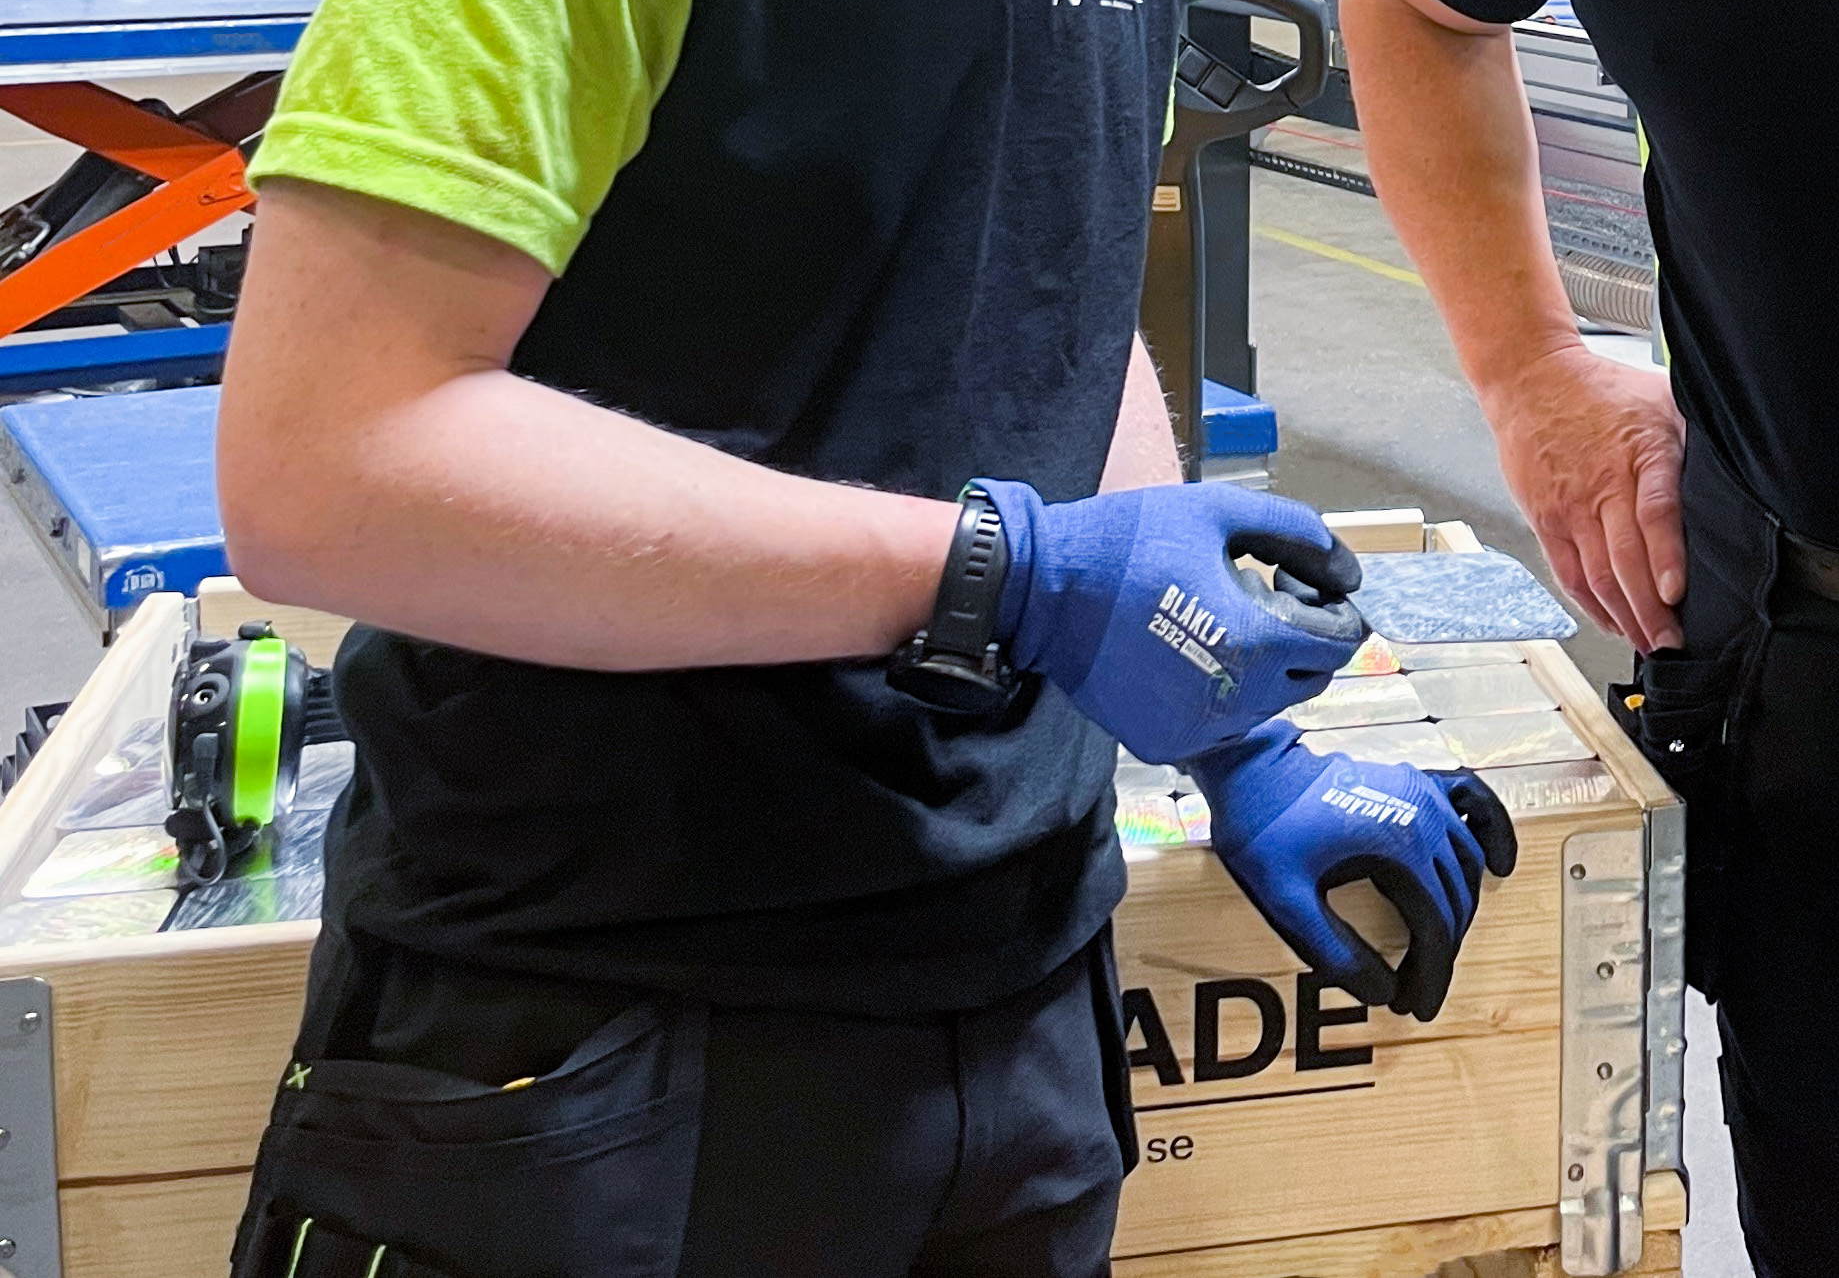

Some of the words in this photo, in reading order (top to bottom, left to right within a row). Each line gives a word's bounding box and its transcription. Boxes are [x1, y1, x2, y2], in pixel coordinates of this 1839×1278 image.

[1147, 612, 1187, 650] 2932
[1121, 971, 1375, 1087] ADE
[1146, 1133, 1195, 1163] se
